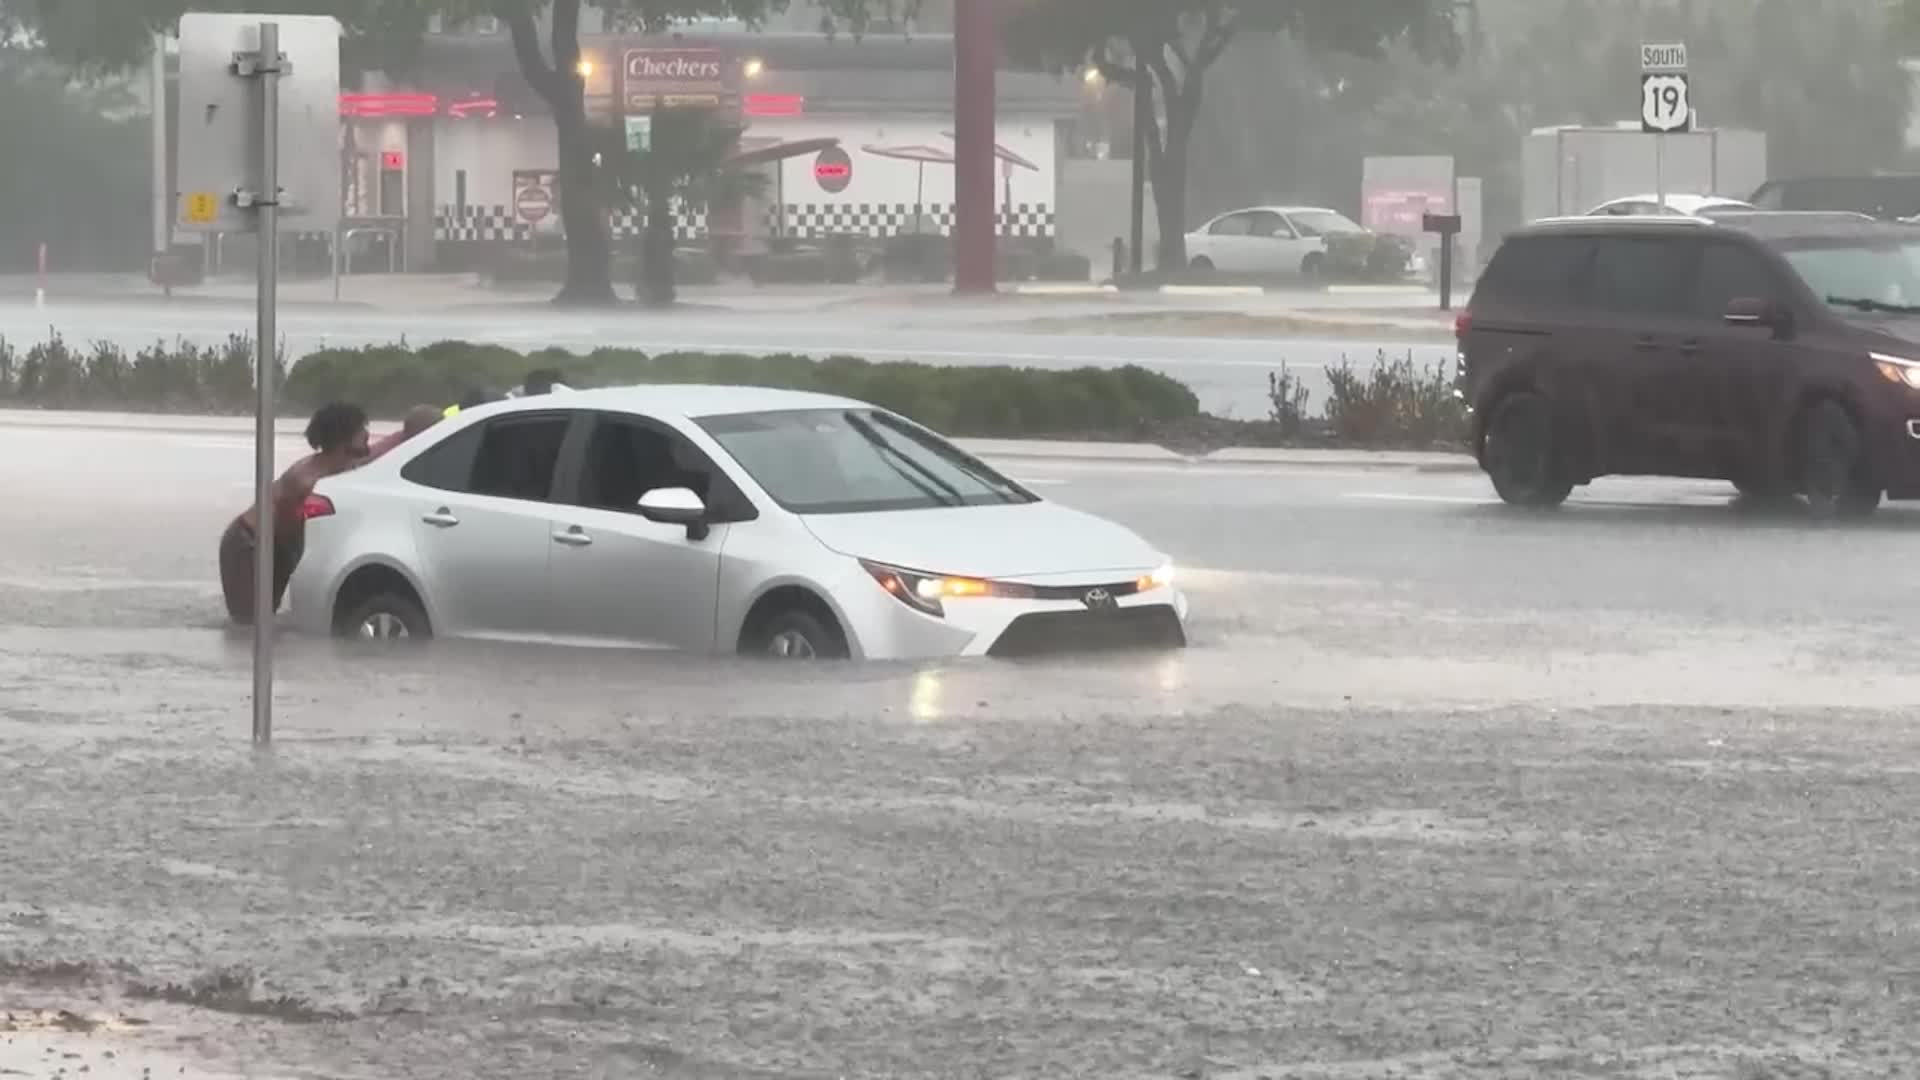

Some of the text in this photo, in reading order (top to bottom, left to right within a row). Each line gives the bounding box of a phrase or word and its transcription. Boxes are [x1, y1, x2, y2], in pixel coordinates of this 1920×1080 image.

[629, 56, 720, 77] Checkers
[1644, 47, 1684, 66] SOUTH
[1652, 86, 1679, 118] 19
